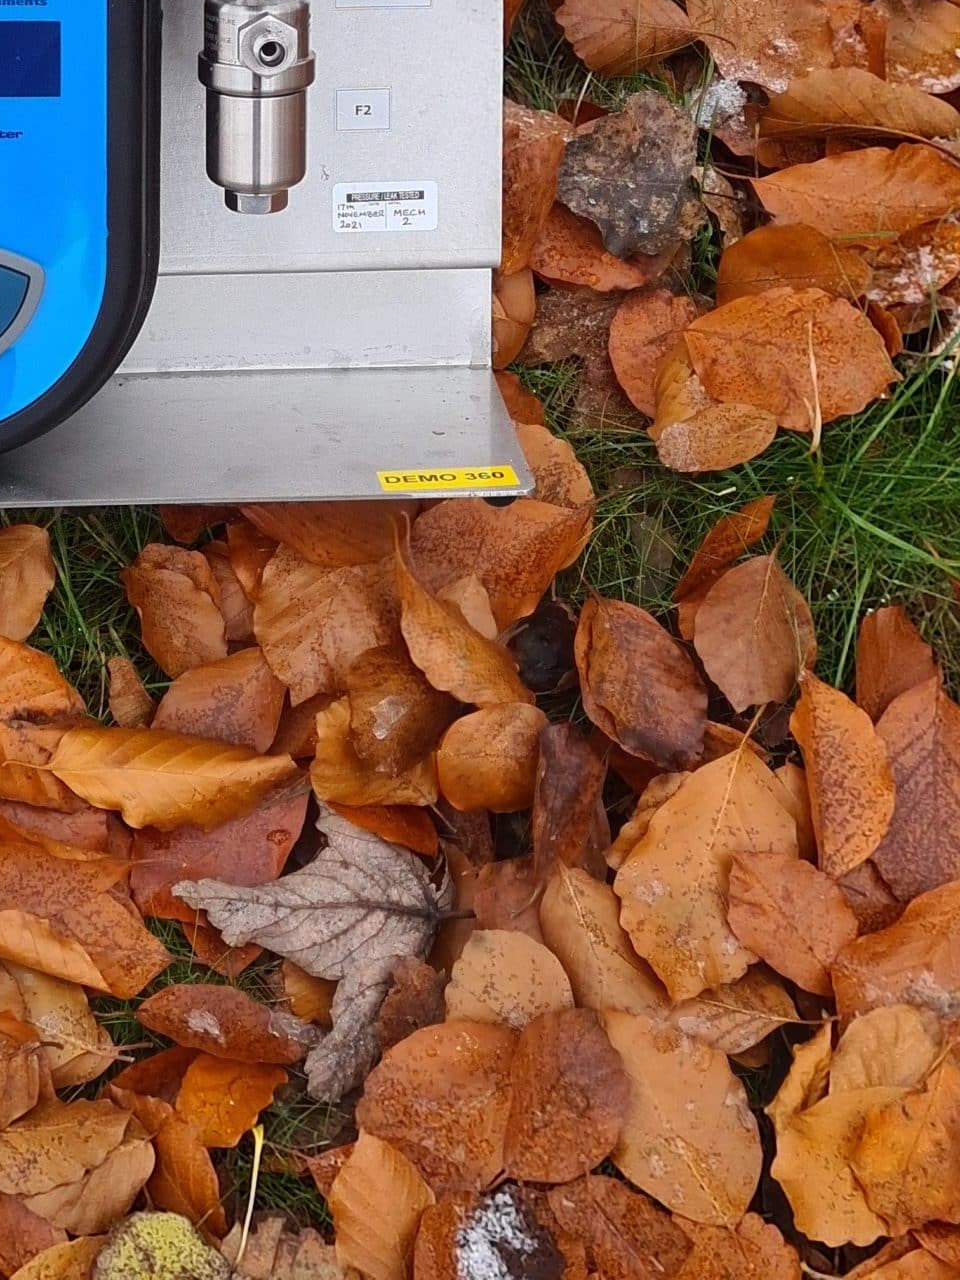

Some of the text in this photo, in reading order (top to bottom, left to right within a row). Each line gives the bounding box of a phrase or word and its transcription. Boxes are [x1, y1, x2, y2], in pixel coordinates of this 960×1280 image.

[355, 105, 372, 116] F2
[393, 209, 426, 217] MECH
[339, 217, 412, 229] 2021 2
[384, 471, 505, 484] DEMO 360
